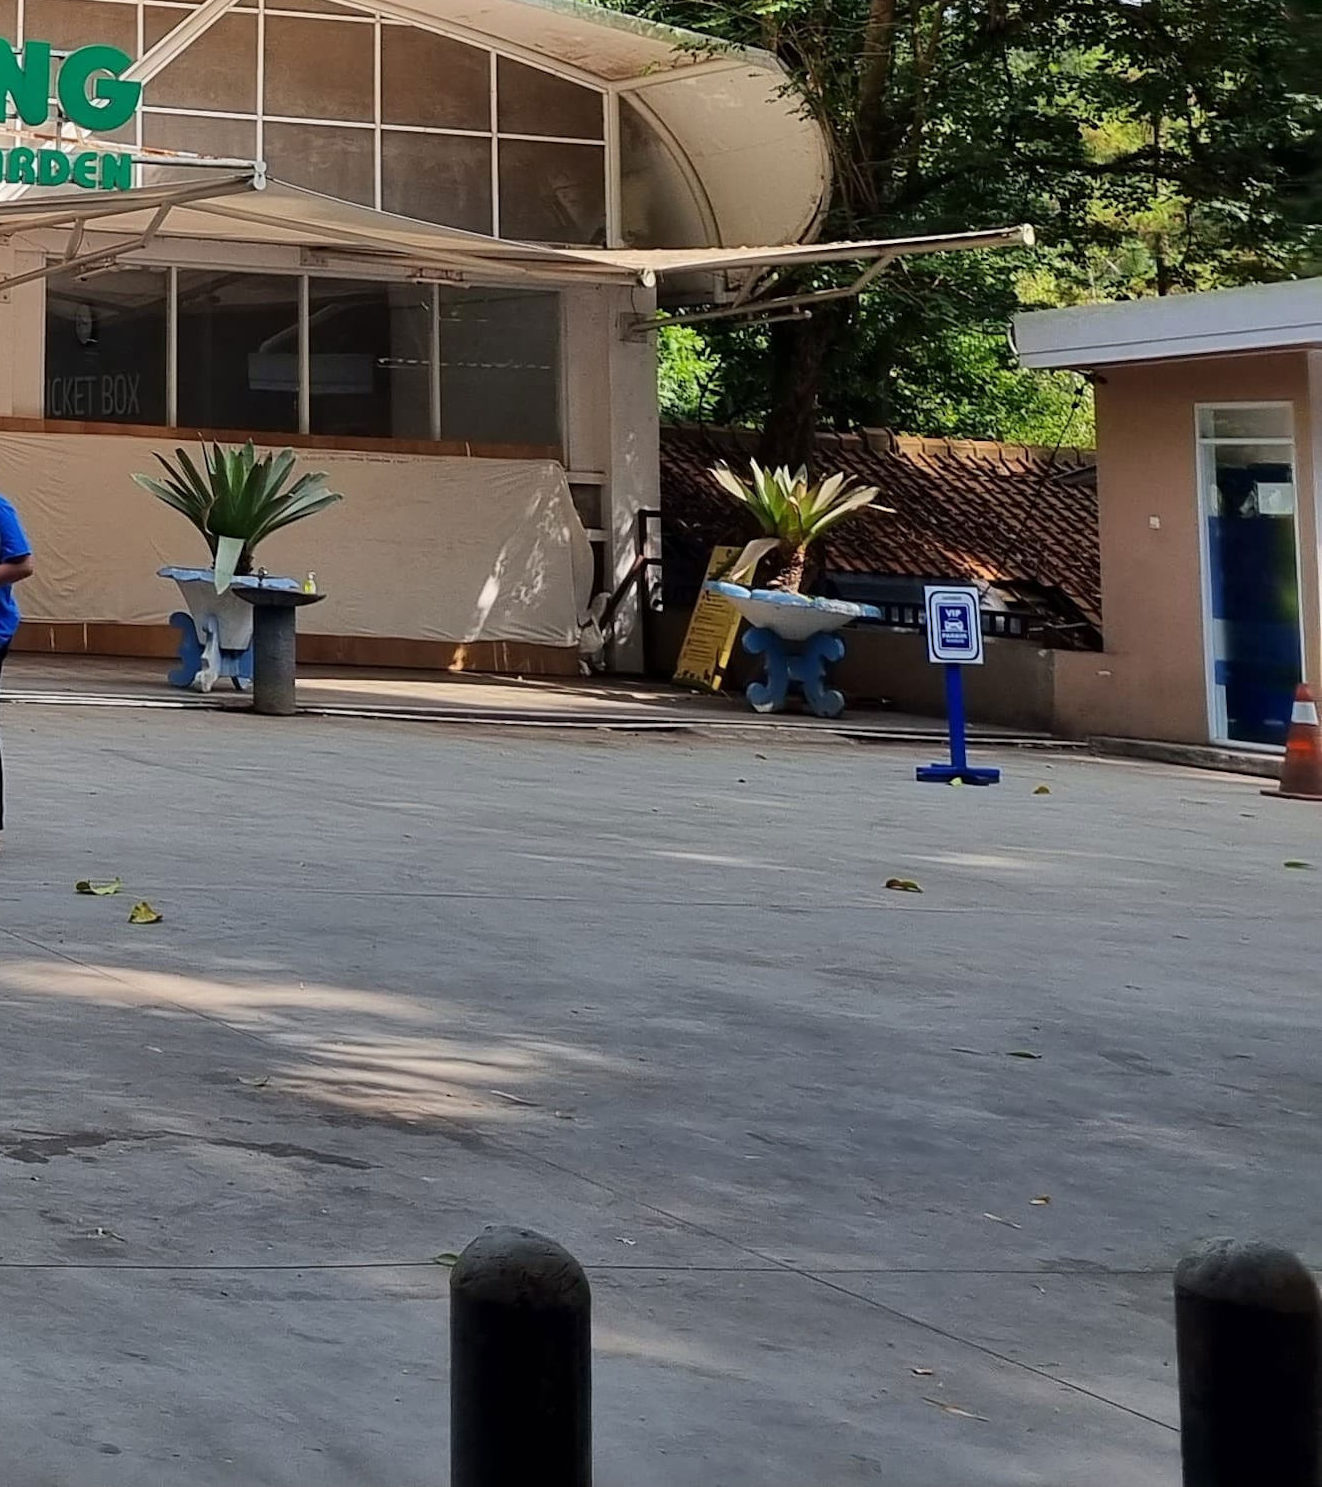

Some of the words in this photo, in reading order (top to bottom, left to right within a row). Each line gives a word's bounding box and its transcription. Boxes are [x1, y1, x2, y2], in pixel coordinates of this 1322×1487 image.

[46, 376, 97, 417] ICKET
[101, 374, 141, 415] BOX
[945, 609, 962, 618] VIP
